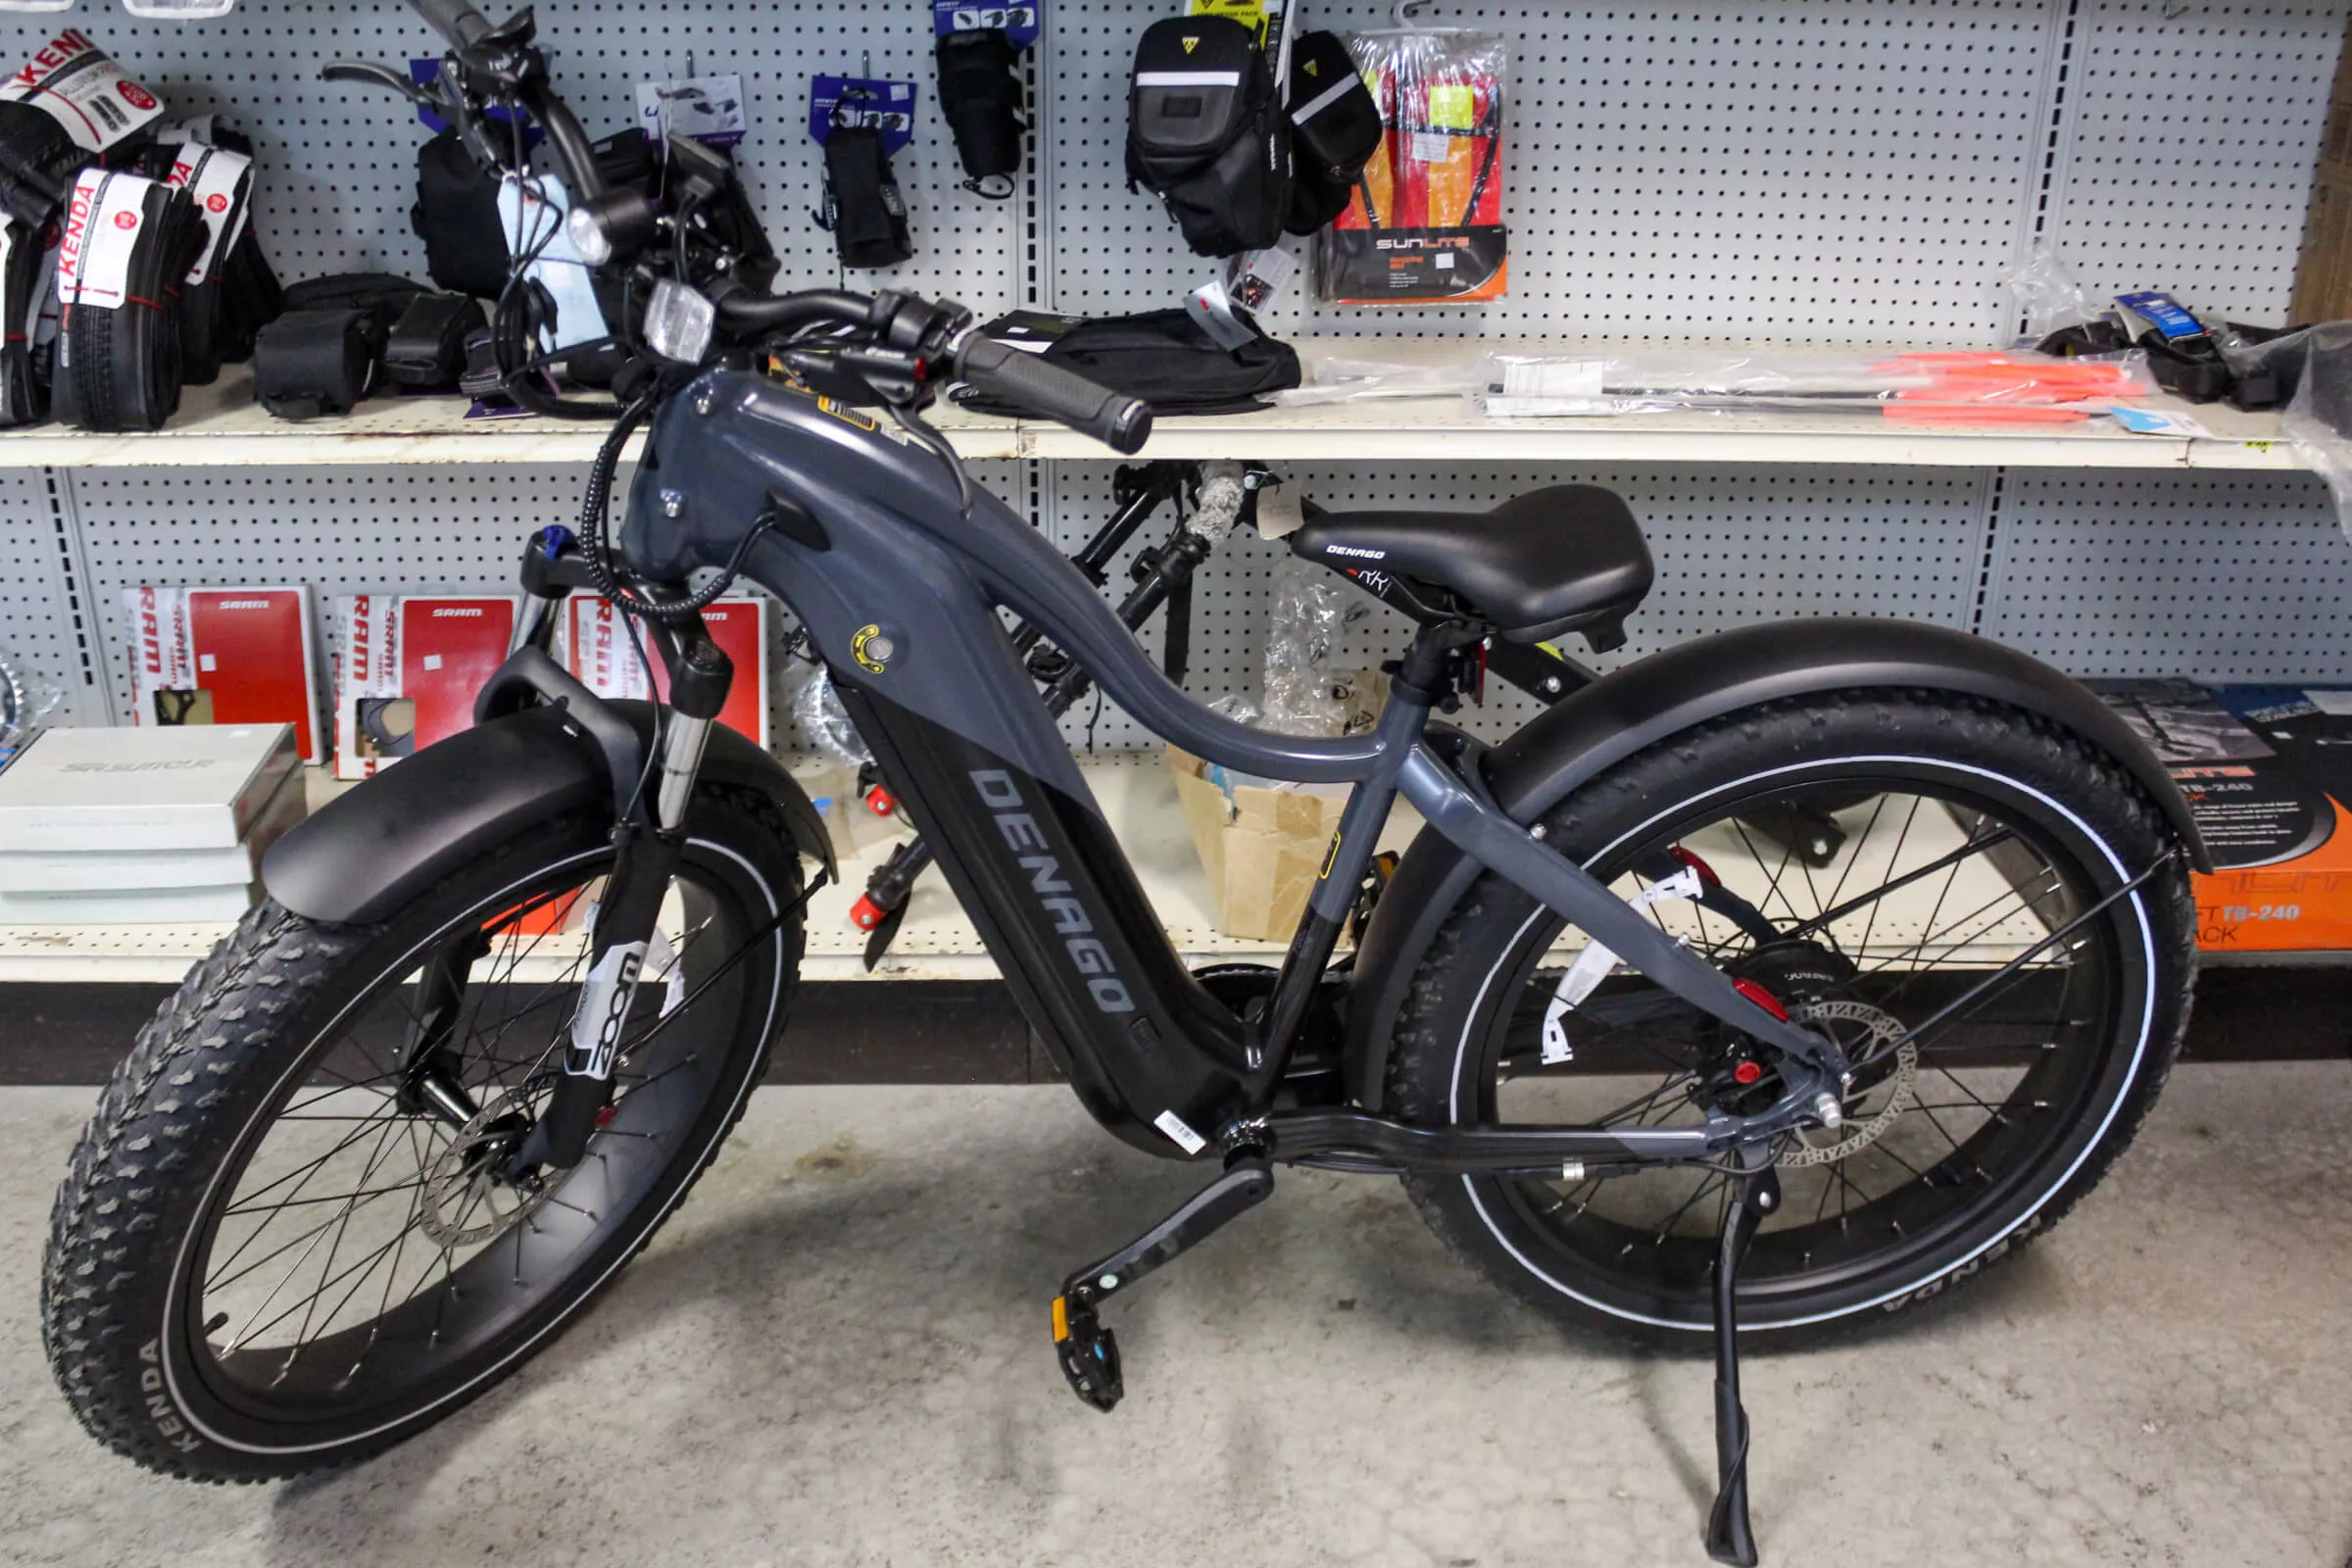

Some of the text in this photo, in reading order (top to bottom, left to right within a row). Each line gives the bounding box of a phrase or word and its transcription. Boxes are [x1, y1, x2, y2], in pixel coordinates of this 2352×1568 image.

[16, 27, 95, 84] KEN
[59, 185, 95, 277] KENDA
[1325, 544, 1386, 560] DENAGO
[139, 587, 162, 674] RAM
[219, 600, 270, 610] SRAM
[353, 595, 370, 682] RAM
[432, 608, 483, 617] SRAM
[596, 599, 612, 688] RAM
[969, 769, 1136, 1013] DENAGO
[2223, 905, 2301, 922] TB-240
[139, 1339, 203, 1452] KENDA
